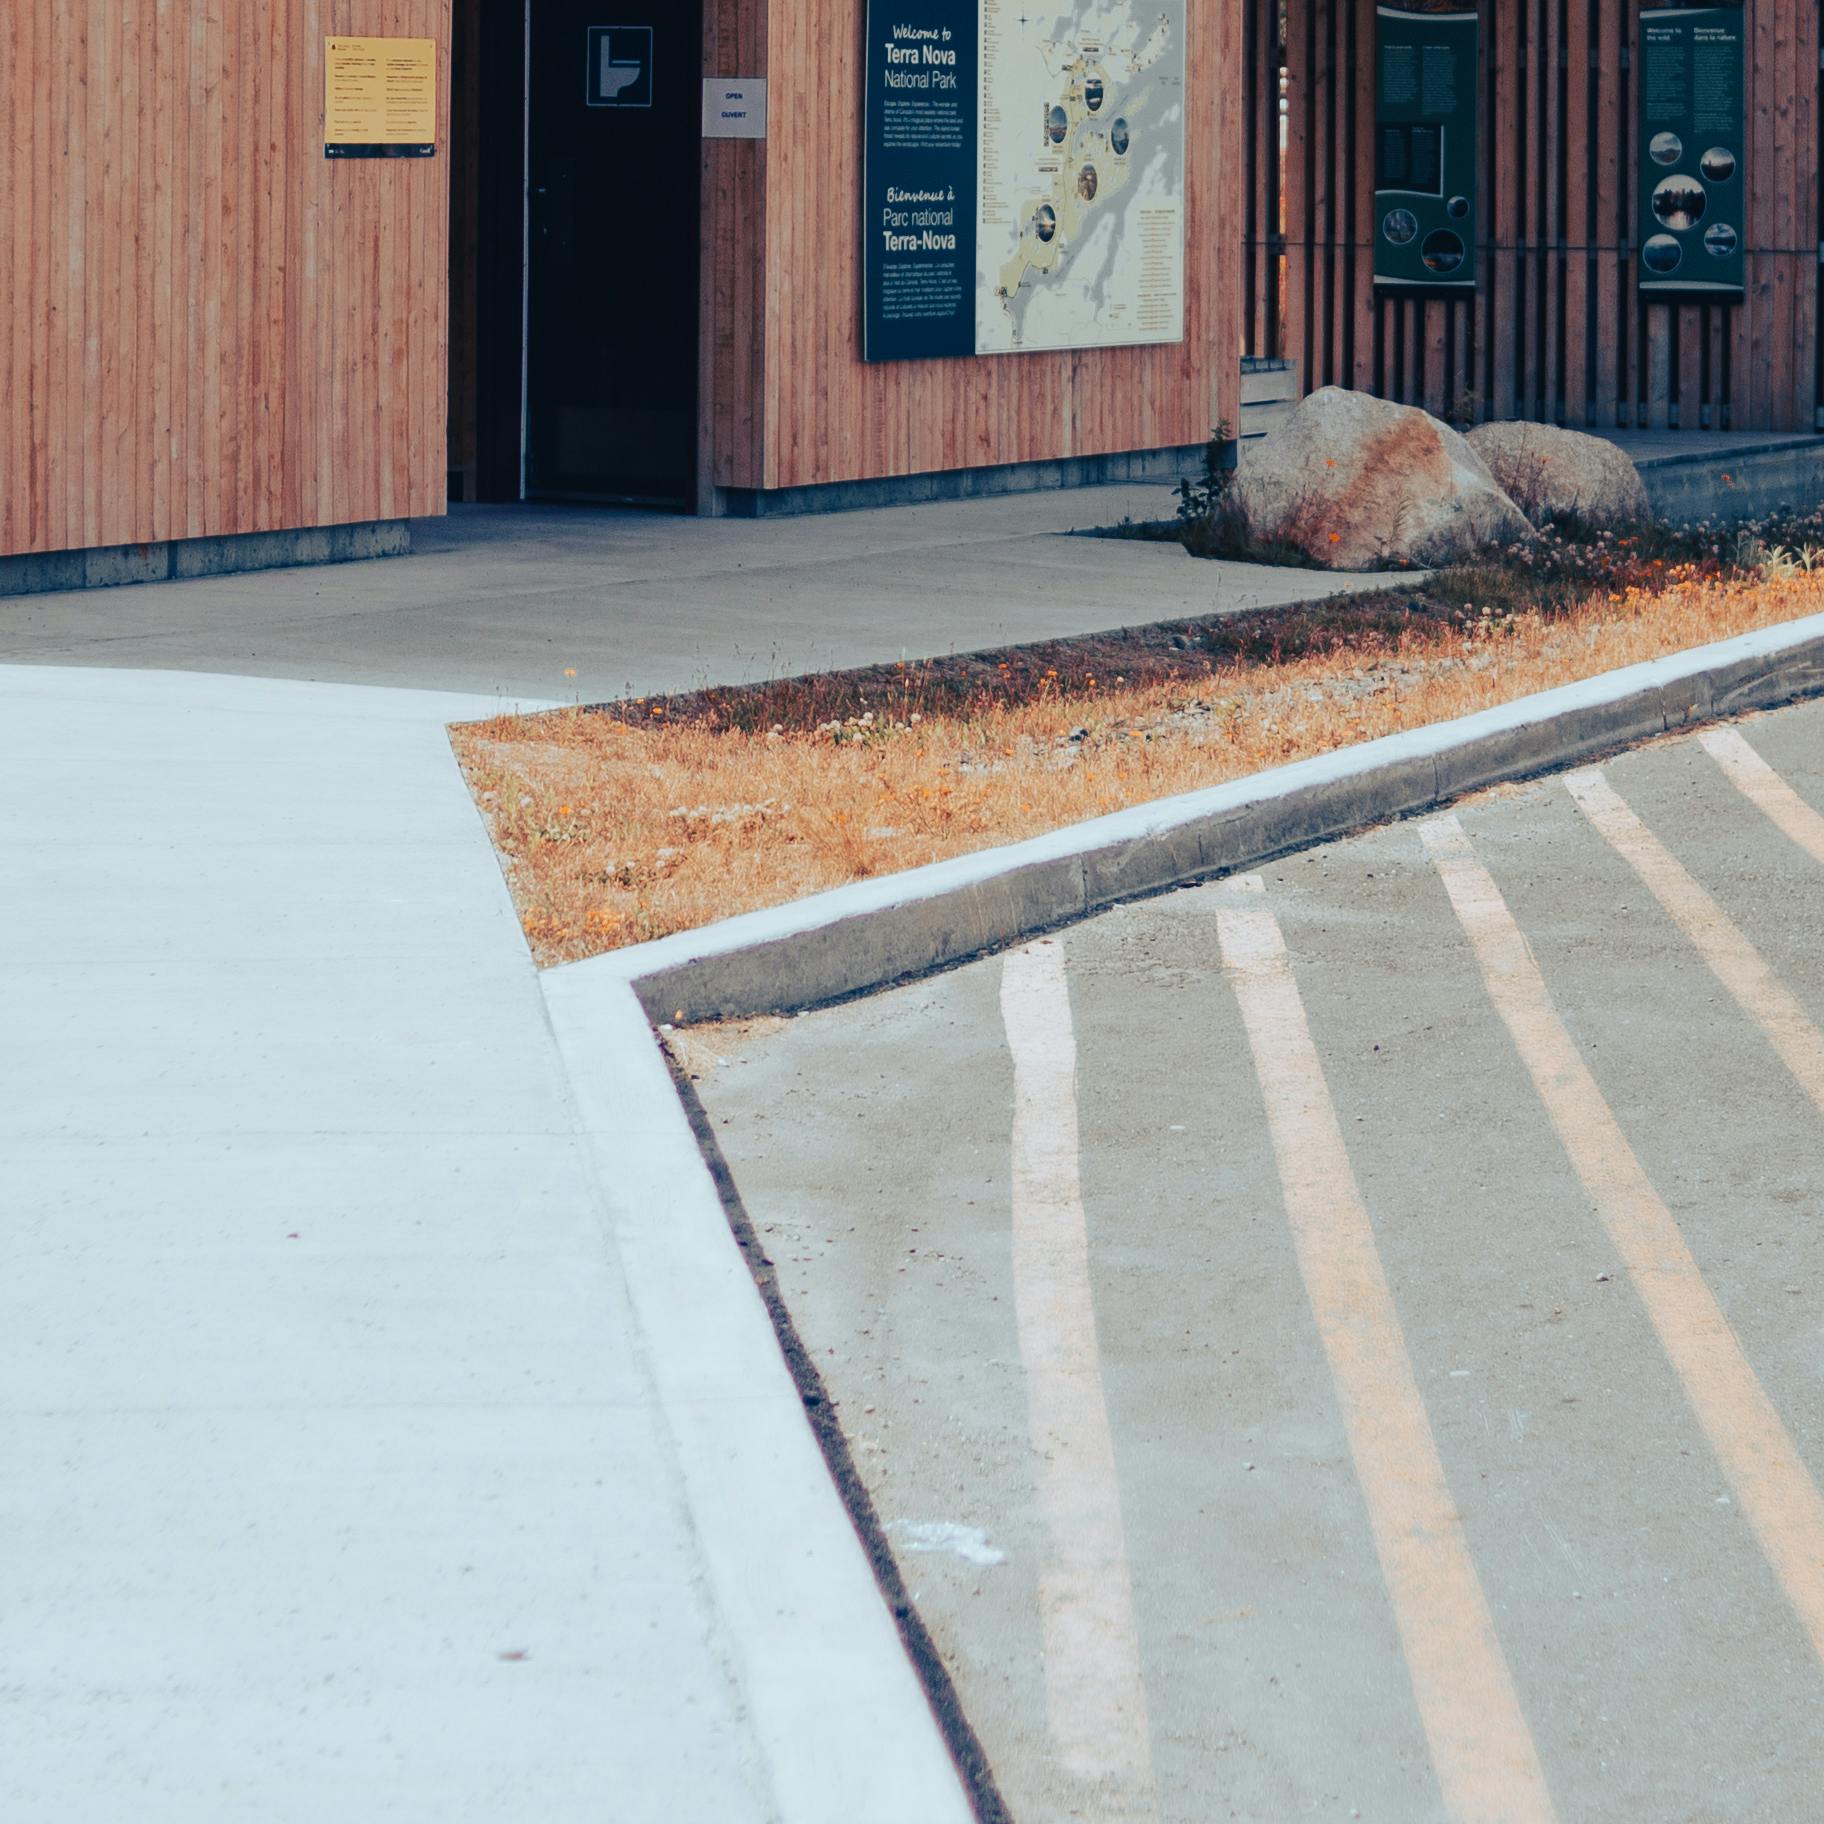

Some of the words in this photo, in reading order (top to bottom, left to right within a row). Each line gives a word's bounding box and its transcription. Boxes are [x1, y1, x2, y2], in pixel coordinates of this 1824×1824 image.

[893, 23, 939, 40] Welcome
[942, 26, 951, 42] to
[884, 43, 919, 64] Terra
[922, 44, 956, 65] Nova
[884, 69, 929, 88] National
[932, 70, 957, 89] Park
[725, 92, 744, 100] OPEN
[720, 111, 747, 119] OUVERT
[887, 186, 944, 203] Bienvenue
[946, 184, 955, 201] à
[883, 207, 909, 227] Parc
[911, 207, 953, 226] national
[883, 229, 956, 252] Terra-Nova
